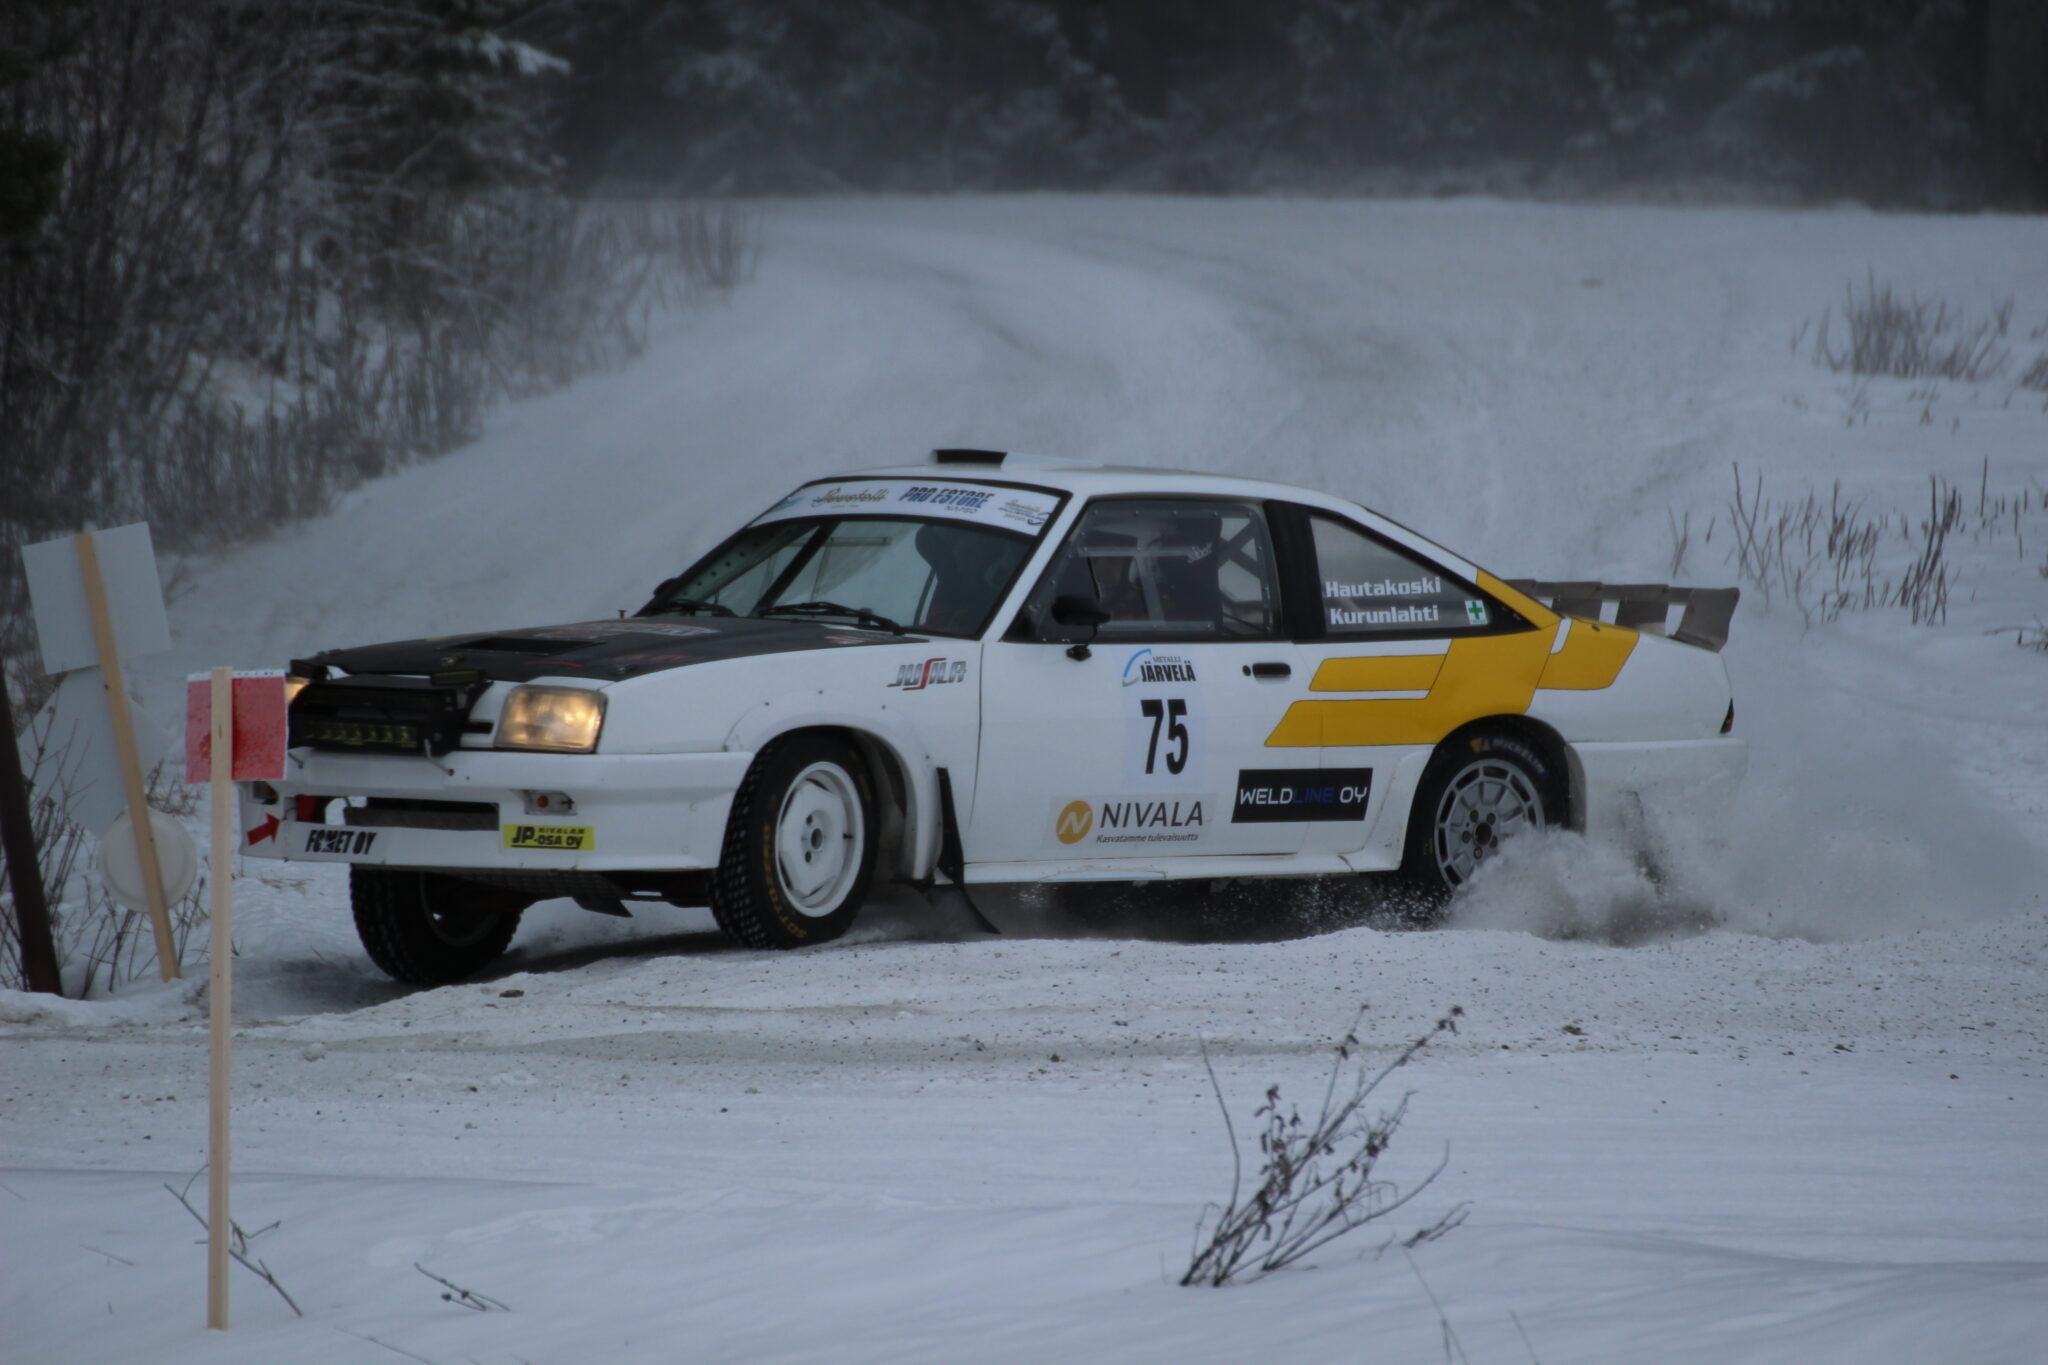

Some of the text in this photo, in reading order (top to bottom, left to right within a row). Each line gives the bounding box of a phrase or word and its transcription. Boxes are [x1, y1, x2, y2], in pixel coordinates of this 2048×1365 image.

[1325, 577, 1442, 598] Hautakoski
[1330, 605, 1440, 625] Kurunlahti
[1140, 660, 1196, 682] JÄRVELÄ
[1141, 699, 1189, 775] 75
[1491, 738, 1546, 774] MICHELIN
[1240, 786, 1368, 805] WELDLINE OY
[1100, 801, 1204, 829] NIVALA
[352, 831, 378, 856] OY
[1096, 832, 1199, 843] Kasvatamme tulevaisuutta
